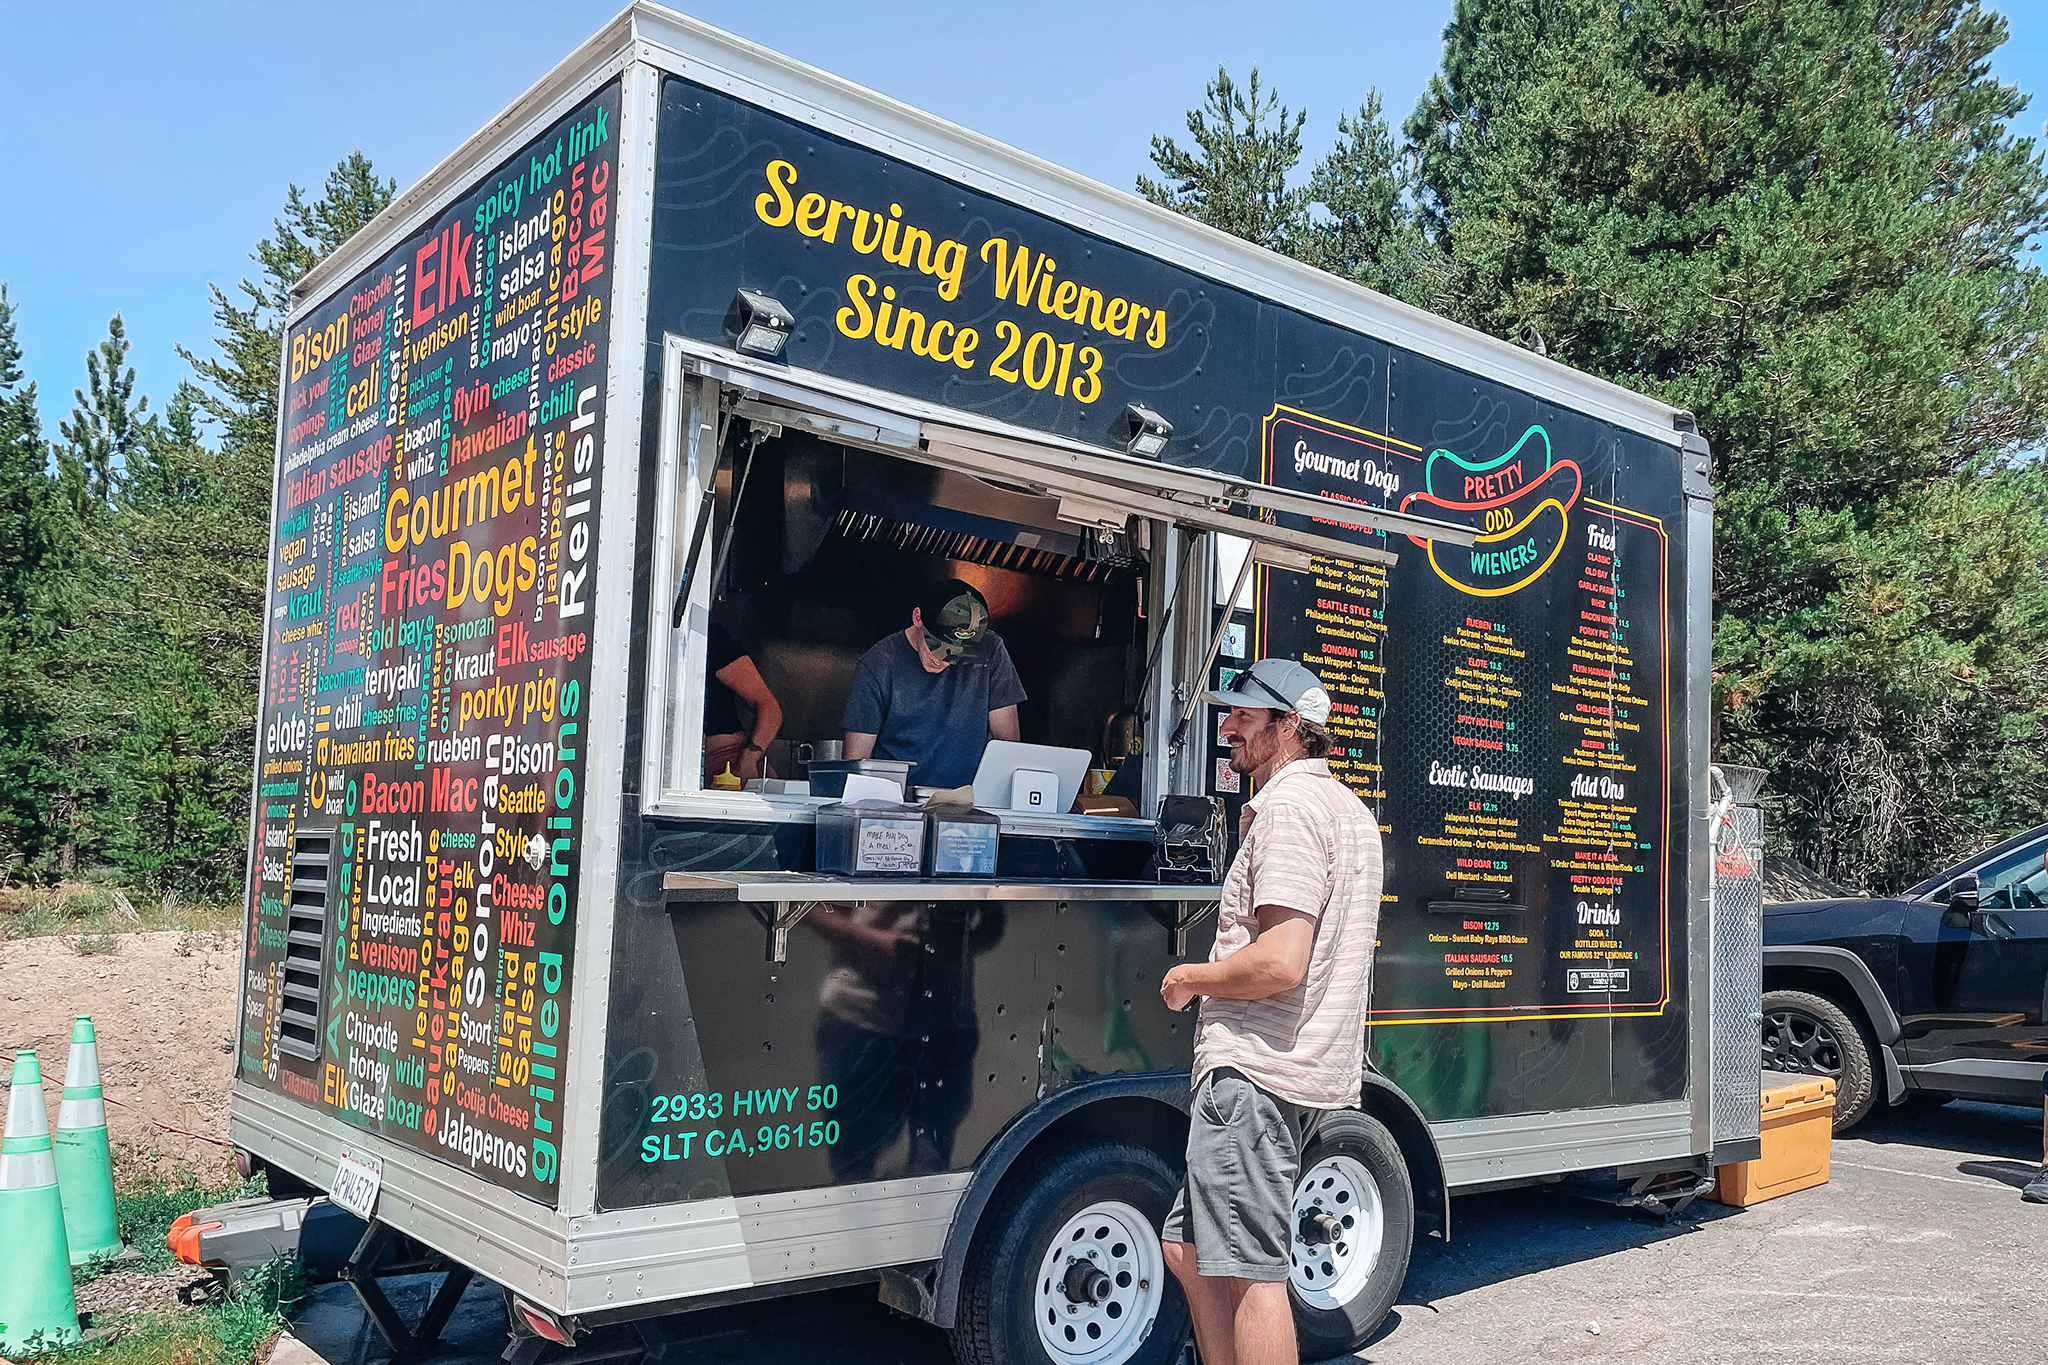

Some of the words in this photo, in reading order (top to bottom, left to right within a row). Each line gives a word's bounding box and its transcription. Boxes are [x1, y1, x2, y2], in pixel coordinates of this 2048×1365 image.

[474, 178, 523, 234] spicy
[530, 137, 563, 195] hot
[567, 105, 610, 167] link
[499, 197, 551, 265] island
[562, 161, 586, 303] Bacon
[580, 158, 610, 285] Mac
[411, 219, 475, 330] Elk
[499, 248, 545, 301] salsa
[544, 188, 565, 355] chicago
[754, 159, 968, 302] Serving
[980, 236, 1167, 350] Wieners
[479, 233, 495, 369] tomatoes
[494, 298, 516, 329] wild
[518, 286, 542, 316] boar
[560, 294, 602, 341] style
[352, 305, 386, 343] Honey
[411, 311, 468, 366] venison
[491, 323, 531, 363] mayo
[834, 273, 980, 370] Since
[989, 319, 1104, 405] 2013
[290, 312, 349, 386] Bison
[352, 335, 383, 368] Glaze
[527, 308, 543, 428] spinach
[547, 339, 596, 383] classic
[346, 358, 380, 418] cali
[491, 366, 531, 401] cheese
[540, 379, 575, 425] chili
[403, 418, 441, 454] bacon
[450, 409, 527, 468] hawaiian
[285, 468, 327, 511] italian
[329, 433, 392, 490] sausage
[407, 448, 435, 482] whiz
[1293, 440, 1360, 482] Gourmet
[1363, 459, 1400, 498] Dogs
[1464, 460, 1523, 500] PRETTY
[348, 482, 381, 524] island
[384, 432, 538, 554] Gourmet
[559, 384, 598, 620] Relish
[545, 429, 566, 605] jalapenos
[1485, 507, 1514, 533] ODD
[1587, 523, 1616, 551] Fries
[348, 526, 376, 558] salsa
[1470, 537, 1538, 576] WIENERS
[1586, 552, 1611, 565] CLASSIC
[380, 554, 446, 615] Fries
[446, 535, 538, 617] Dogs
[1315, 577, 1342, 592] Mustard
[1345, 583, 1366, 599] Celery
[1366, 588, 1379, 599] Salt
[1578, 579, 1599, 592] GARLIC
[1599, 584, 1615, 596] PARM
[288, 583, 324, 621] kraut
[1305, 608, 1344, 624] Philadelphia
[1344, 615, 1365, 628] Cream
[1365, 619, 1388, 632] Cheese
[1316, 597, 1349, 613] SEATTLE
[1349, 603, 1371, 618] STYLE
[1372, 608, 1384, 620] 9.5
[371, 619, 395, 653] old
[398, 614, 425, 652] bay
[443, 615, 495, 645] sonoran
[497, 620, 530, 668] Elk
[1465, 616, 1493, 631] RUEBEN
[1493, 622, 1507, 634] 13.5
[454, 644, 496, 682] kraut
[530, 631, 587, 663] sausage
[1321, 642, 1358, 658] SONORAN
[1359, 649, 1375, 660] 10.5
[1467, 657, 1488, 669] ELOTE
[1489, 660, 1503, 671] 13.5
[364, 653, 422, 703] teriyaki
[334, 692, 363, 732] chili
[459, 675, 519, 732] porky
[522, 668, 557, 726] pig
[1361, 706, 1377, 717] 10.5
[267, 709, 307, 755] elote
[1457, 714, 1476, 725] SPICY
[1476, 717, 1488, 727] HOT
[1489, 718, 1505, 729] LINK
[1505, 721, 1516, 731] 9.5
[310, 704, 332, 810] Cali
[427, 730, 482, 764] rueben
[502, 735, 555, 776] Bison
[1347, 747, 1364, 758] 10.5
[1452, 735, 1475, 747] VEGAN
[1474, 738, 1504, 751] SAUSAGE
[1505, 742, 1519, 752] 9.75
[361, 772, 425, 814] Bacon
[430, 767, 479, 813] Mac
[498, 782, 546, 814] Seattle
[1428, 760, 1468, 788] Exotic
[1470, 765, 1534, 800] Sausages
[1571, 773, 1598, 798] Add
[1600, 776, 1624, 800] Ons
[1468, 801, 1482, 812] ELK
[1482, 802, 1499, 812] 12.75
[366, 819, 422, 864] Fresh
[440, 827, 476, 849] cheese
[453, 861, 475, 890] elk
[465, 733, 501, 1009] Sonoran
[1456, 858, 1474, 868] WILD
[1474, 859, 1492, 869] BOAR
[1492, 860, 1508, 870] 12.75
[366, 864, 422, 908] Local
[492, 872, 545, 911] Cheese
[326, 779, 358, 1061] Avocado
[361, 906, 422, 939] Ingredients
[500, 909, 536, 948] Whiz
[529, 951, 563, 1185] grilled
[546, 678, 580, 926] onions
[1462, 920, 1484, 930] BISON
[1483, 921, 1500, 931] 12.75
[1577, 901, 1621, 925] Drinks
[1588, 928, 1605, 938] SODA
[1605, 928, 1610, 938] 2
[361, 936, 418, 974] venison
[412, 828, 440, 1049] lemonade
[1444, 953, 1470, 963] ITALIAN
[1469, 953, 1501, 963] SAUSAGE
[1500, 953, 1514, 963] 10.5
[1574, 940, 1600, 949] BOTTLED
[1599, 940, 1618, 949] WATER
[1618, 940, 1623, 949] 2
[1604, 951, 1634, 960] LEMONADE
[1634, 951, 1639, 960] 6
[346, 968, 417, 1013] peppers
[423, 859, 455, 1138] sauerkraut
[443, 896, 470, 1098] sausage
[345, 1011, 399, 1055] Chipotle
[460, 1010, 492, 1048] Sport
[495, 951, 520, 1089] Island
[512, 961, 537, 1088] Salsa
[348, 1046, 391, 1094] Honey
[395, 1053, 426, 1090] wild
[457, 1047, 490, 1076] Peppers
[323, 1062, 350, 1112] Elk
[349, 1081, 385, 1122] Glaze
[651, 1093, 724, 1123] 2933
[733, 1086, 799, 1116] HWY
[806, 1084, 838, 1111] 50
[387, 1086, 424, 1131] boar
[437, 1106, 527, 1179] Jalapenos
[640, 1131, 698, 1163] SLT
[704, 1120, 840, 1158] CA,96150
[333, 1166, 374, 1212] 4PW4573
